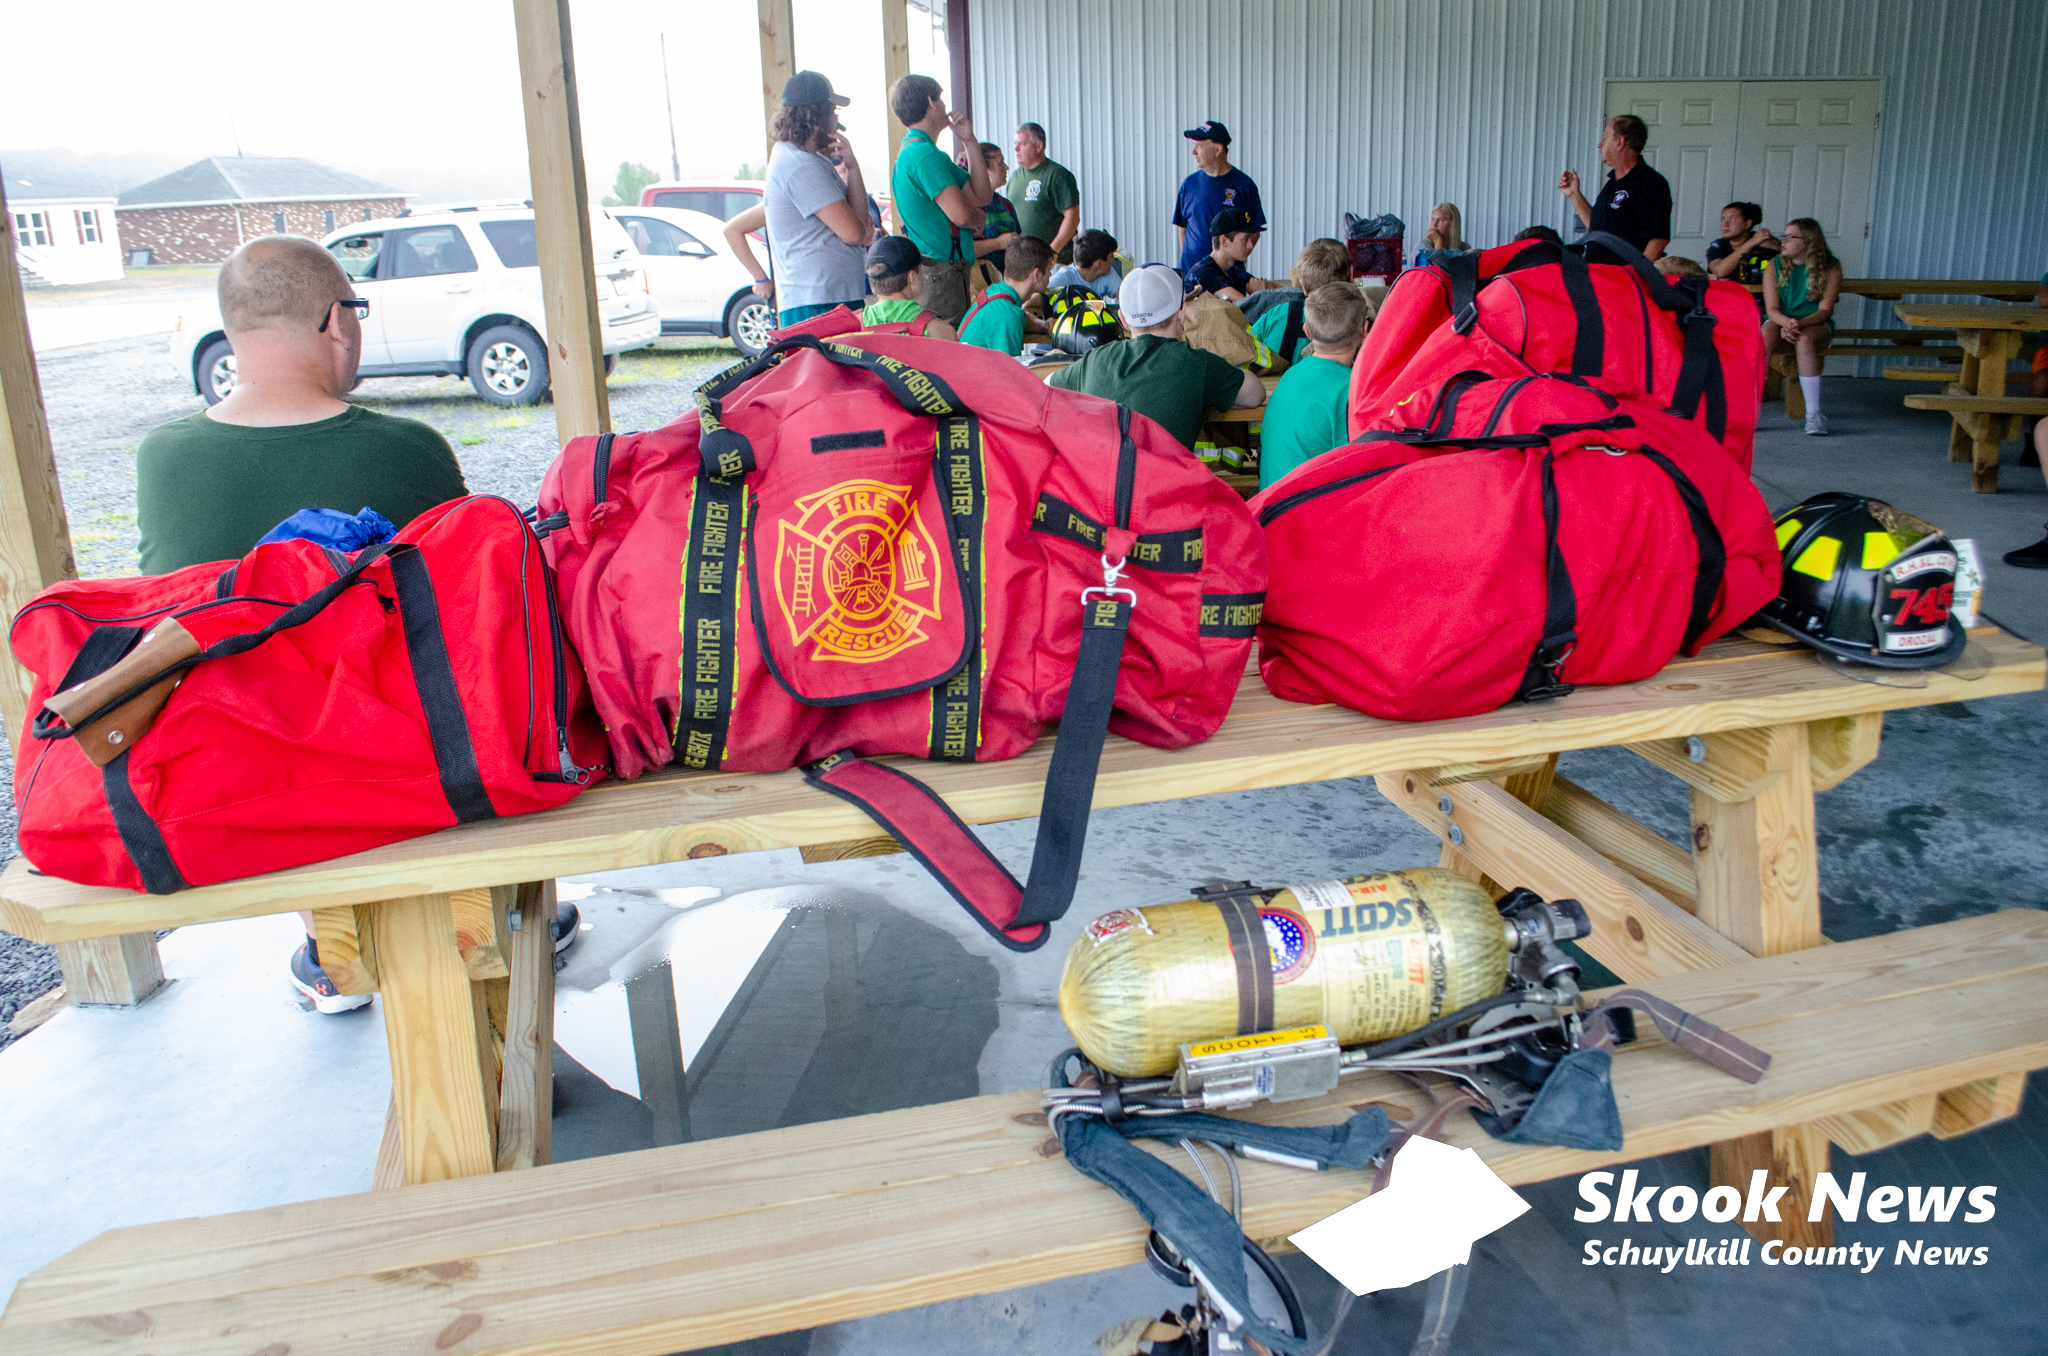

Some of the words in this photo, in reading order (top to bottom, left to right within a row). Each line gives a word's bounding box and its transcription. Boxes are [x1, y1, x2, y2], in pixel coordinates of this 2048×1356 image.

[898, 368, 953, 415] FIGHTER
[826, 492, 889, 519] FIRE
[950, 454, 973, 516] FIGHTER
[701, 501, 730, 557] FIGHTER
[1067, 512, 1097, 543] FIRE
[698, 561, 724, 594] FIRE
[695, 617, 721, 683] FIGHTER
[818, 609, 917, 651] RESCUE
[693, 687, 718, 720] FIRE
[943, 701, 969, 757] FIGHTER
[1320, 897, 1414, 938] SCOTT
[1202, 1034, 1286, 1054] SCOTT
